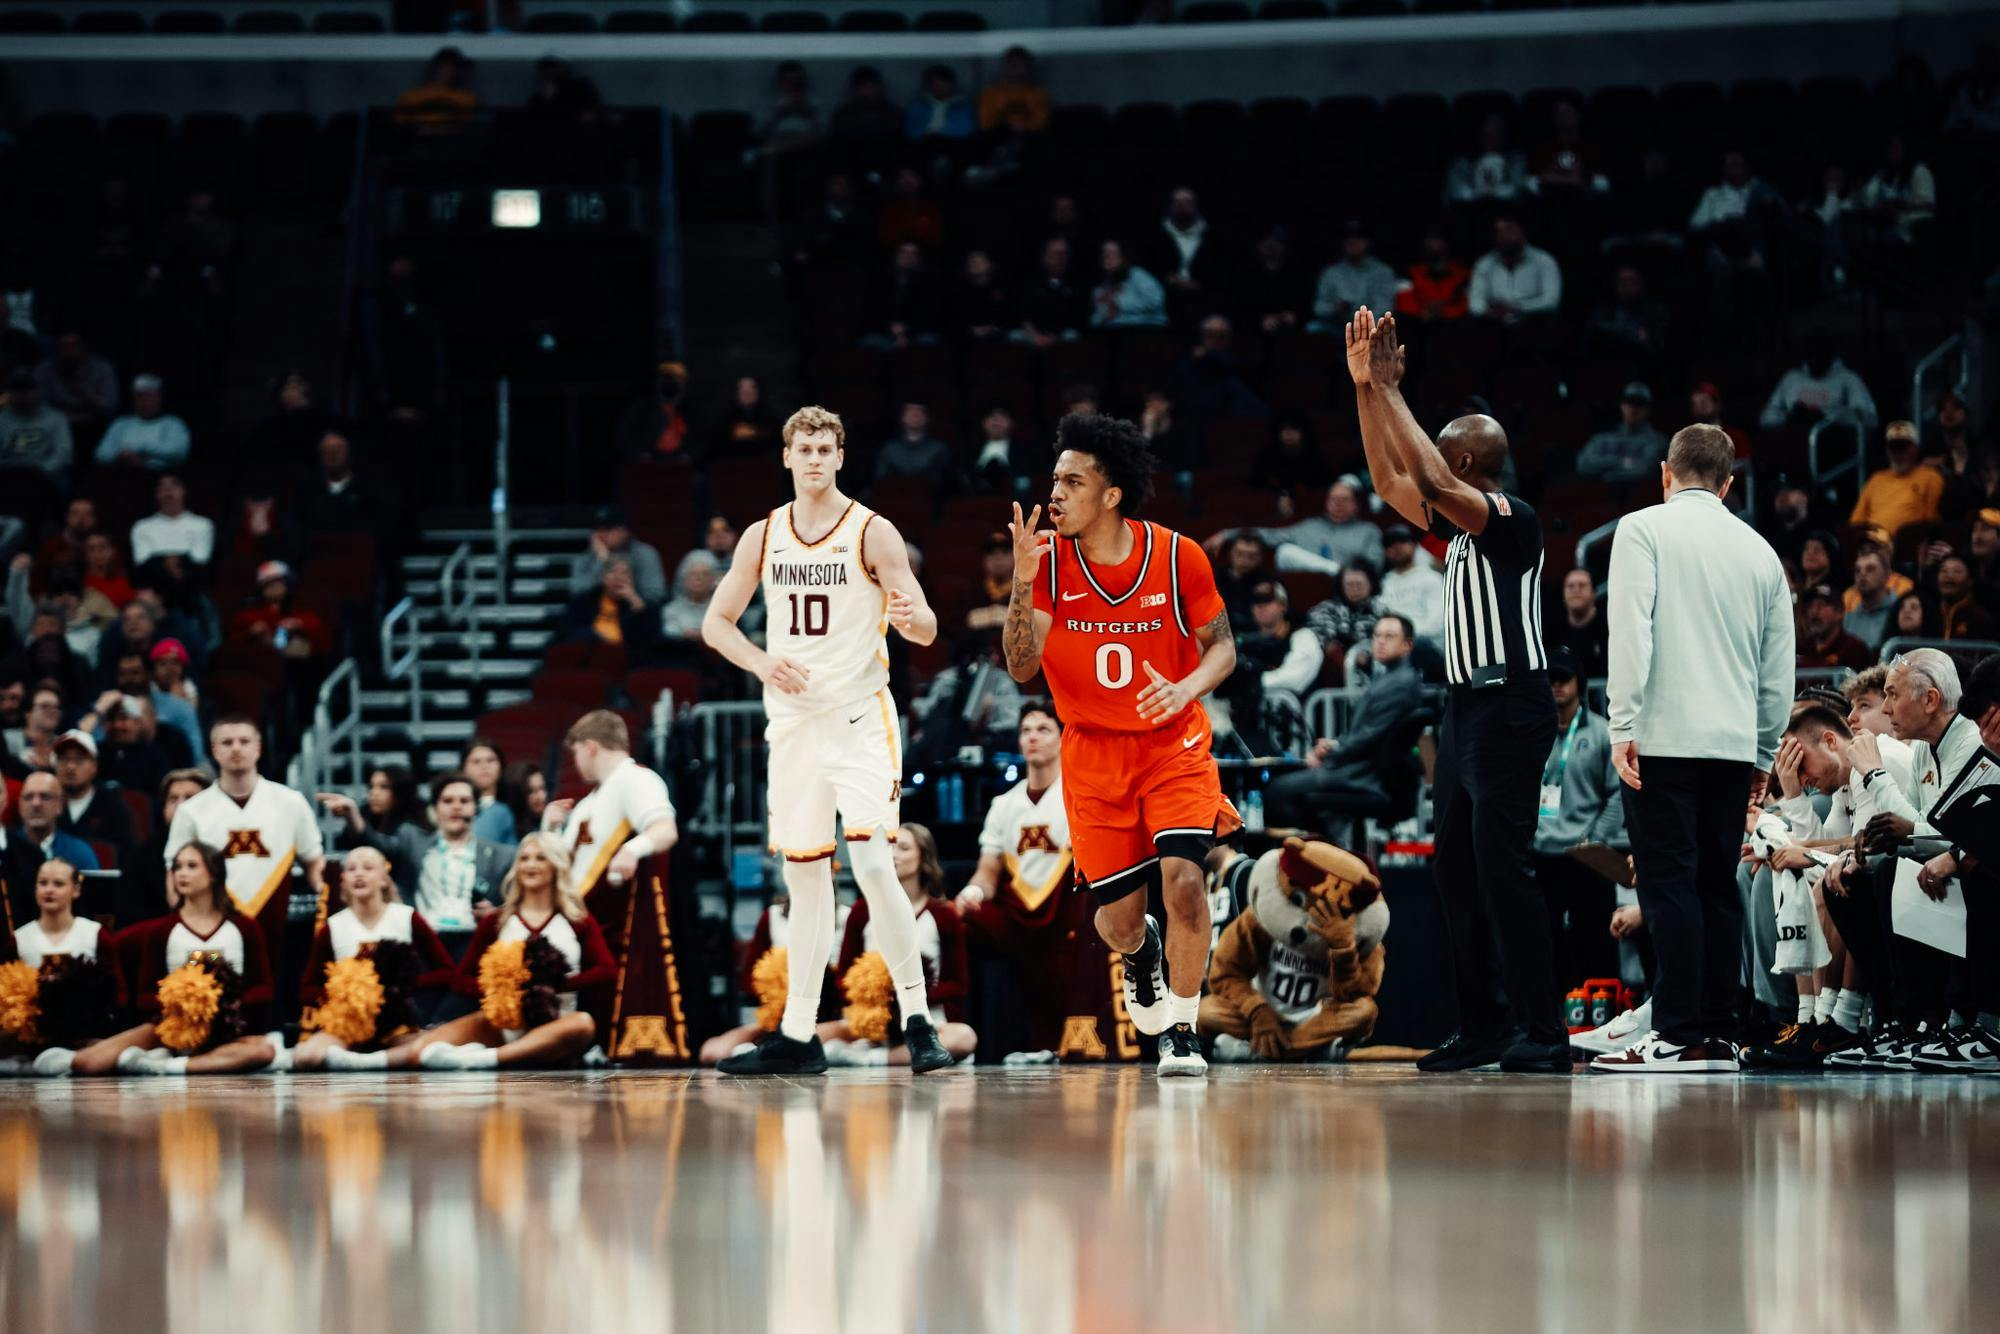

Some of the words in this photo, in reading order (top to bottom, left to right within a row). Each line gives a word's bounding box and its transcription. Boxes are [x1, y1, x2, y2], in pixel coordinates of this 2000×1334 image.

[772, 563, 847, 586] MINNESOTA
[788, 593, 829, 636] 10
[1066, 618, 1163, 634] RUTGERS
[1095, 642, 1133, 690] 0
[1273, 971, 1319, 1008] 00
